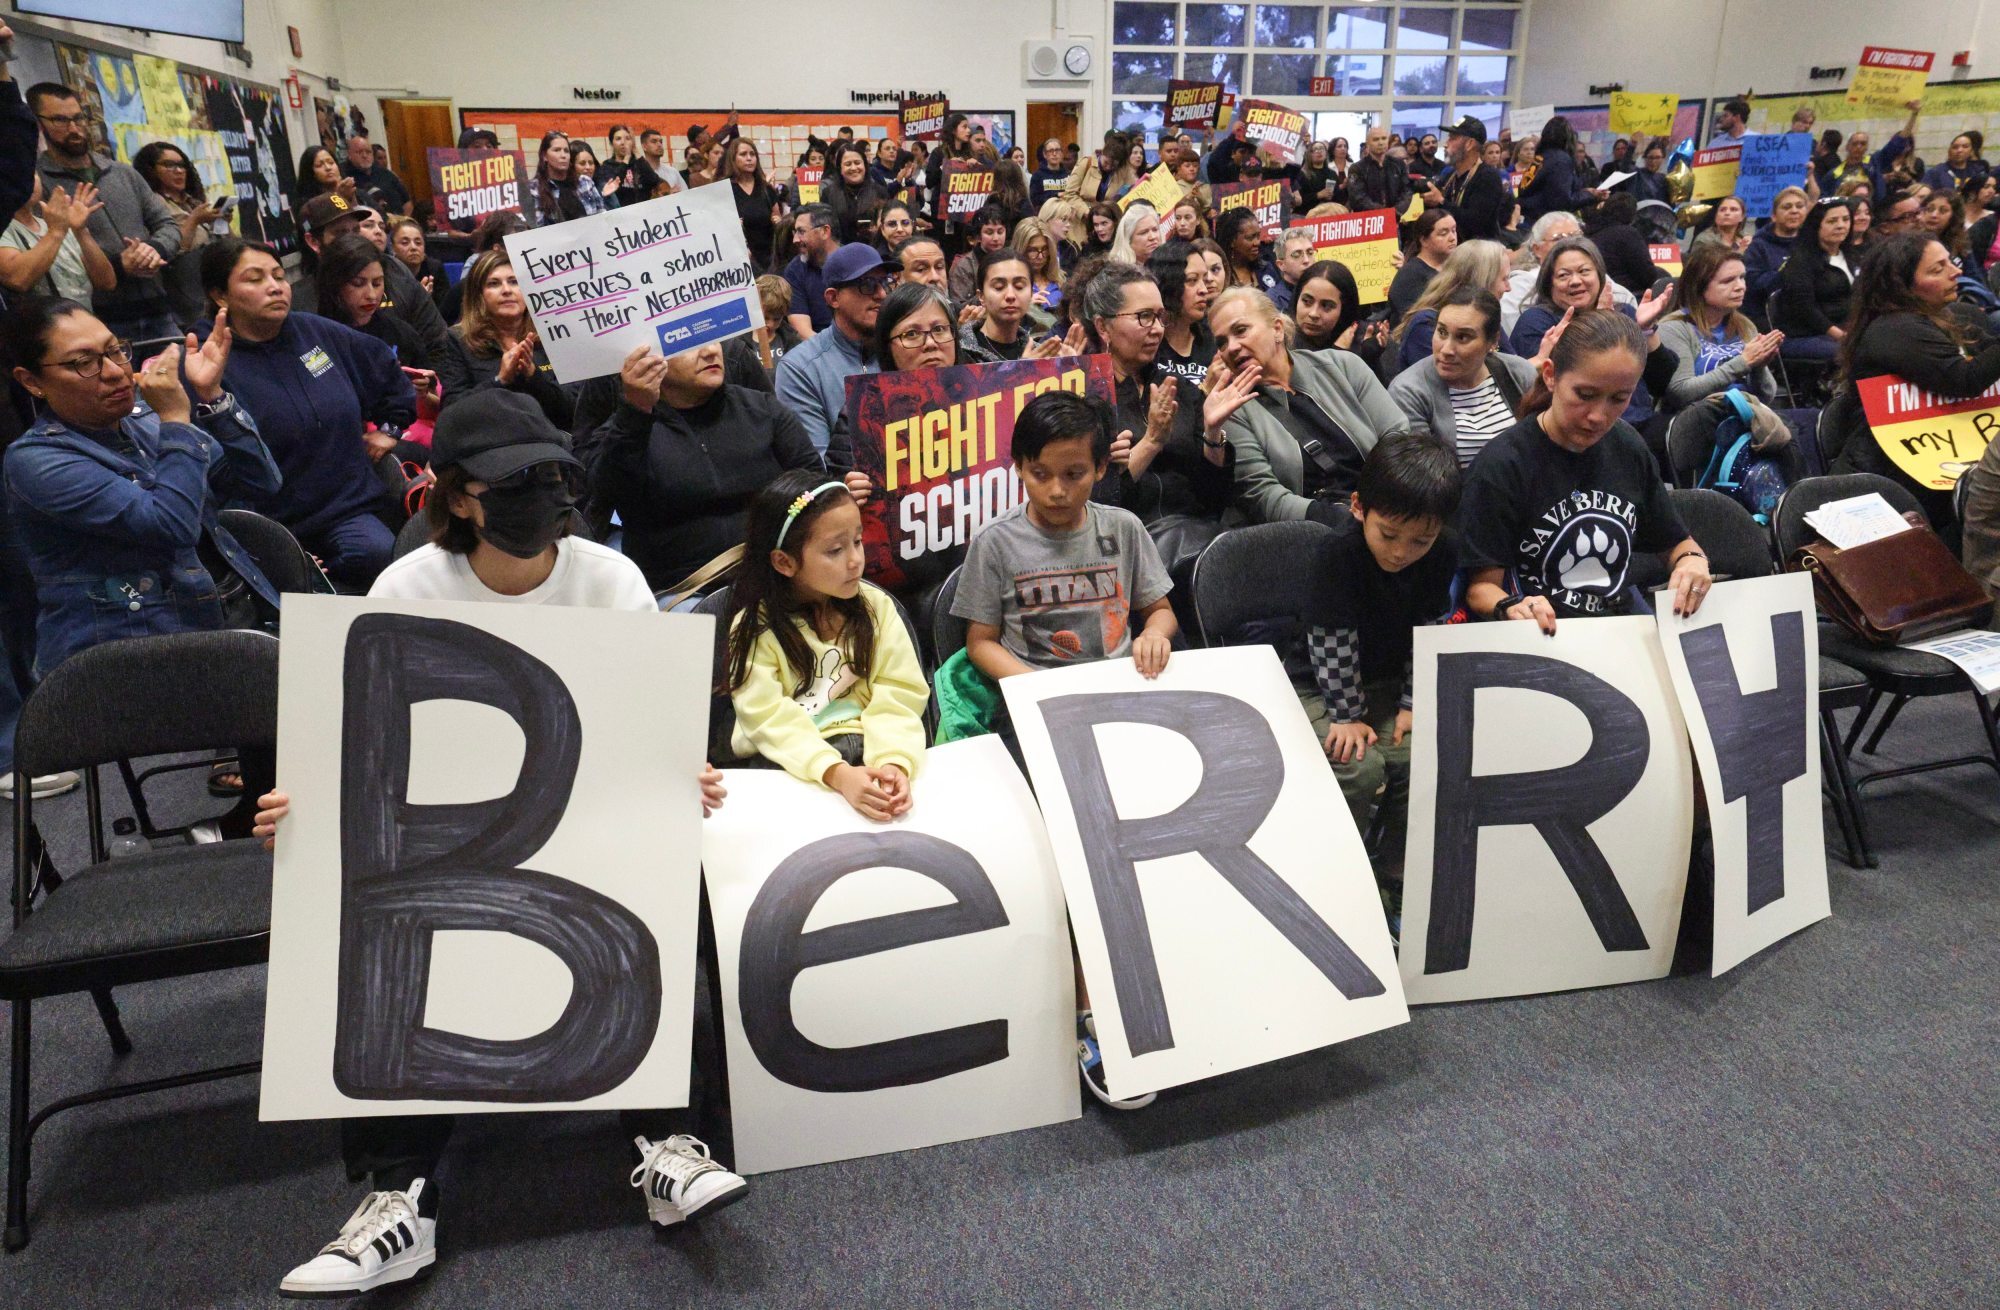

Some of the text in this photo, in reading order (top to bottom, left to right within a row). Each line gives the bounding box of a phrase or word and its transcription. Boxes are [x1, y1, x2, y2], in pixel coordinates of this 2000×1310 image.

[1810, 66, 1847, 81] Berry
[573, 87, 621, 100] Nestor
[851, 90, 947, 105] Imperial Beach
[1172, 88, 1200, 106] FIGHT
[1200, 85, 1219, 101] FOR
[1313, 81, 1332, 94] EXIT
[904, 102, 945, 122] FIGHT FOR
[1171, 104, 1215, 122] SCHOOLS!
[1615, 95, 1633, 108] Be
[905, 115, 944, 136] SCHOOLS!
[1246, 108, 1305, 133] FIGHT FOR
[1245, 124, 1300, 150] SCHOOLS!
[1756, 136, 1789, 152] CSEA
[441, 155, 516, 193] FIGHT FOR
[948, 172, 981, 193] FIGHT
[448, 181, 520, 221] SCHOOLS!
[1220, 183, 1282, 213] FIGHT FOR
[1320, 219, 1361, 242] FIGHTING
[1364, 215, 1384, 236] FOR
[521, 206, 692, 280] Every student
[1657, 248, 1672, 260] FOR
[528, 233, 723, 314] DESERVES a school
[544, 320, 571, 341] in
[579, 303, 638, 333] their
[664, 326, 693, 344] CTA
[1887, 382, 1920, 414] I'M
[885, 391, 1002, 492] FIGHT
[1899, 429, 1959, 458] my
[1520, 499, 1572, 557] SAVE
[1016, 569, 1117, 606] TITAN
